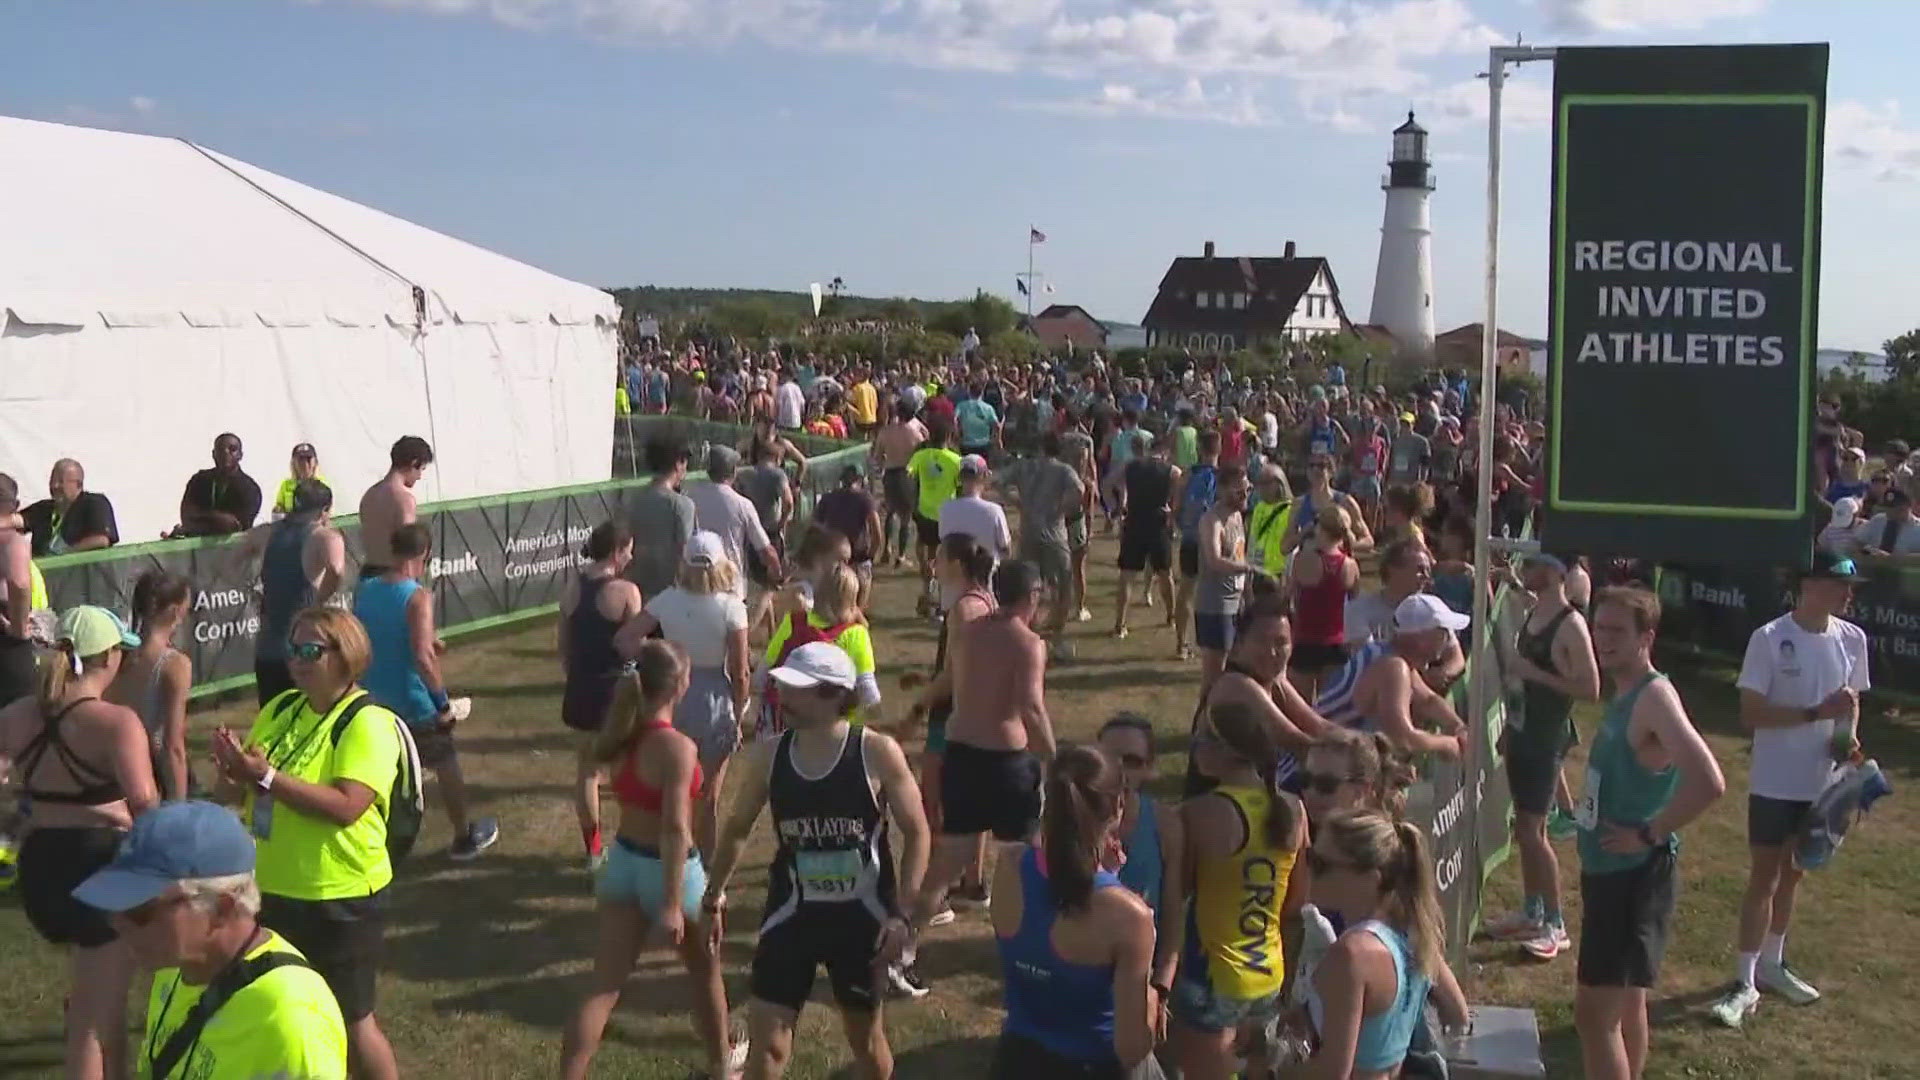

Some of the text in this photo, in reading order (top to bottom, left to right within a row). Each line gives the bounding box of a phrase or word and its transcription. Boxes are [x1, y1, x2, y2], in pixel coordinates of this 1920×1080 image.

[1574, 240, 1793, 273] REGIONAL
[1598, 286, 1767, 319] INVITED
[1576, 332, 1784, 366] ATHLETES
[505, 528, 565, 553] America's
[430, 552, 478, 578] Bank
[505, 552, 574, 579] Convenient
[1691, 582, 1747, 608] Bank
[1237, 857, 1276, 976] CROW
